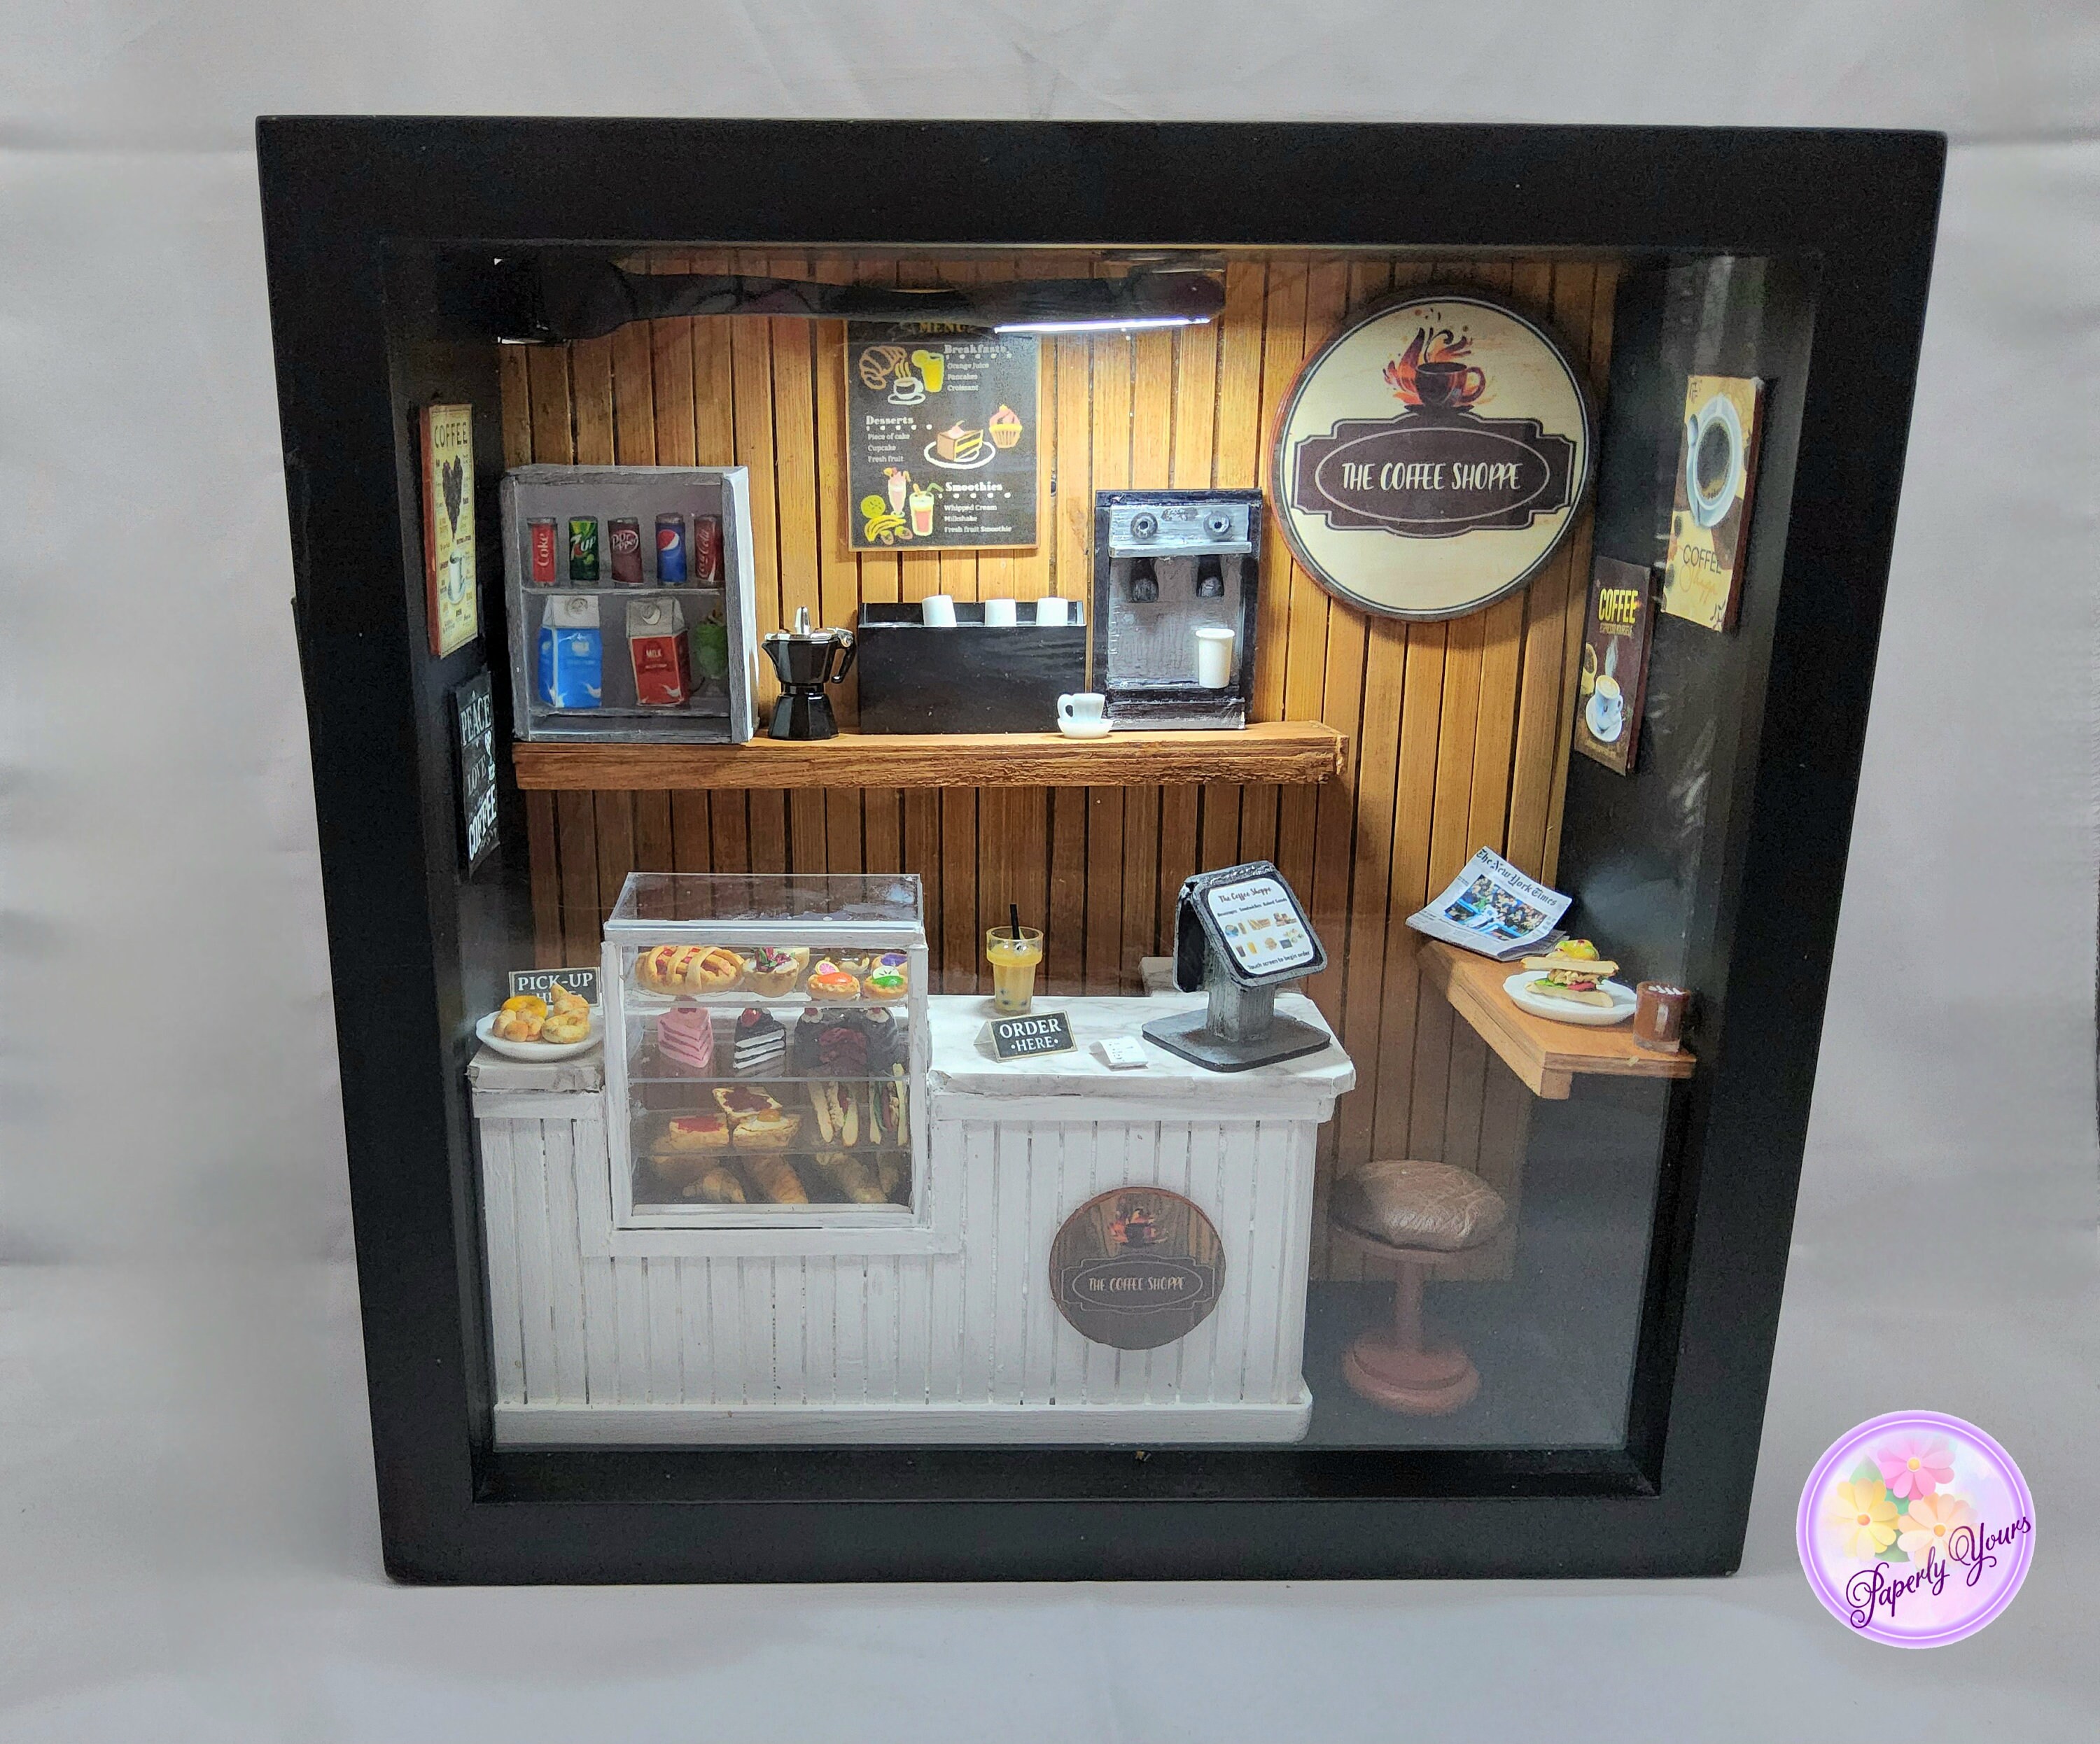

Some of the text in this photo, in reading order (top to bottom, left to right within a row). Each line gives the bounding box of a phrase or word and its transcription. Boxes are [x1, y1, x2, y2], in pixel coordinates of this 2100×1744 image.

[866, 415, 913, 425] Desserts
[434, 421, 468, 449] COFFEE
[868, 444, 897, 453] Cupcake
[945, 481, 1003, 491] Smoothies
[1342, 461, 1524, 491] THE COFFEE SHOPPE
[944, 504, 974, 512] Whipped
[537, 532, 550, 566] Coke
[1683, 544, 1722, 575] COFFEE
[1598, 587, 1639, 624] COFFEE
[645, 648, 662, 659] MILK
[460, 694, 491, 747] PEACE
[467, 754, 486, 796] LOVE
[468, 783, 497, 862] COFFEE
[1476, 848, 1558, 906] The New York Times
[1231, 891, 1250, 901] Coffee
[1250, 887, 1272, 896] Shoppe
[517, 972, 594, 991] PICK-UP
[999, 1018, 1062, 1039] ORDER
[1014, 1036, 1055, 1053] HERE
[1088, 1276, 1185, 1293] THE COFFEE SHOPPE
